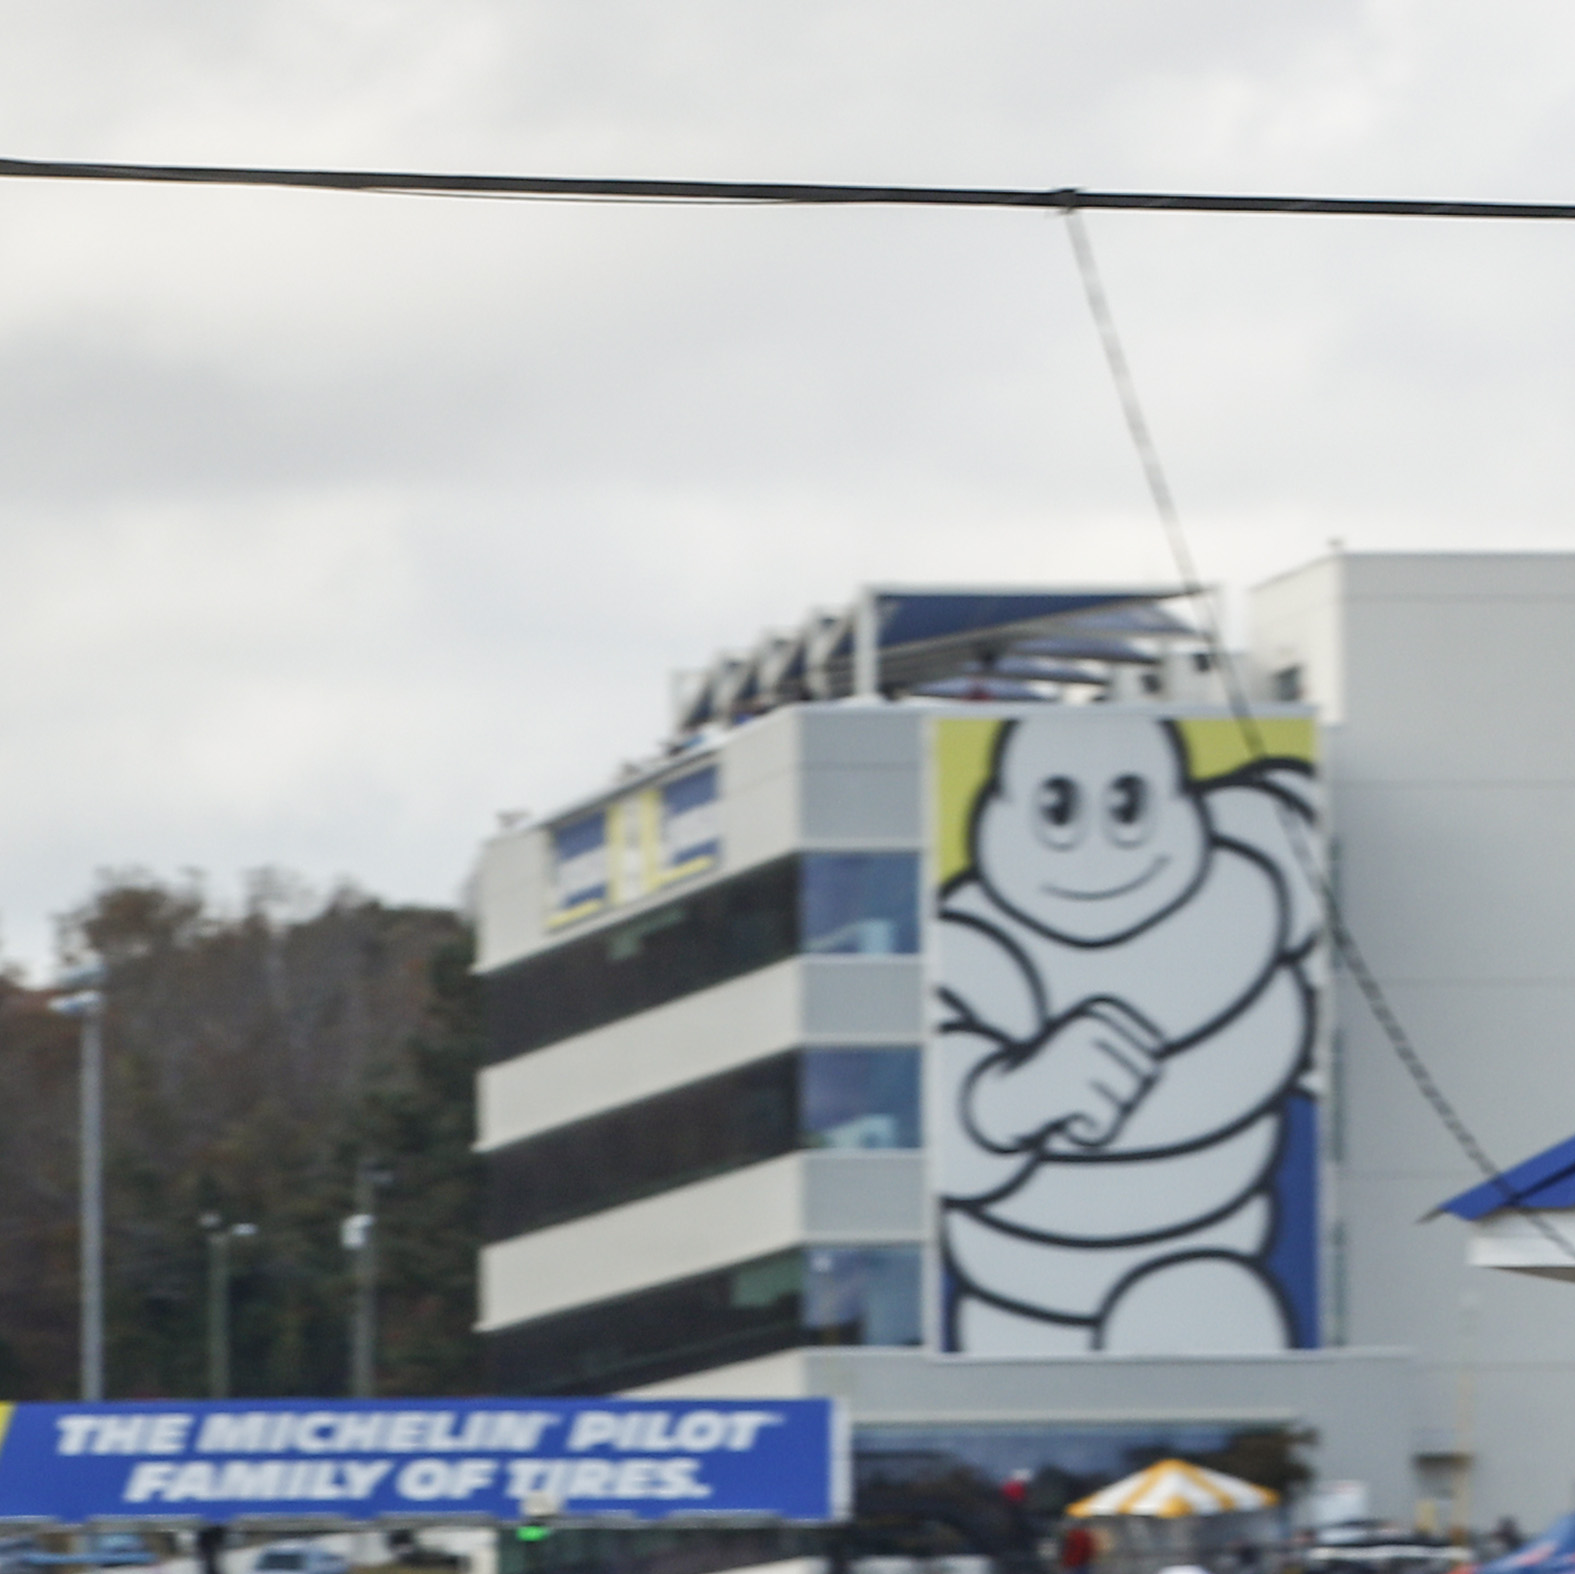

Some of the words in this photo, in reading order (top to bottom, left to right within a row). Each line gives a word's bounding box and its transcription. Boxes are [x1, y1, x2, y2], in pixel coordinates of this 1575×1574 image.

[57, 1413, 195, 1456] THE
[196, 1411, 557, 1454] MICHELIN
[566, 1410, 780, 1453] PILOT
[122, 1459, 394, 1501] FAMILY
[395, 1458, 498, 1500] OF
[506, 1458, 713, 1499] TIRES.
